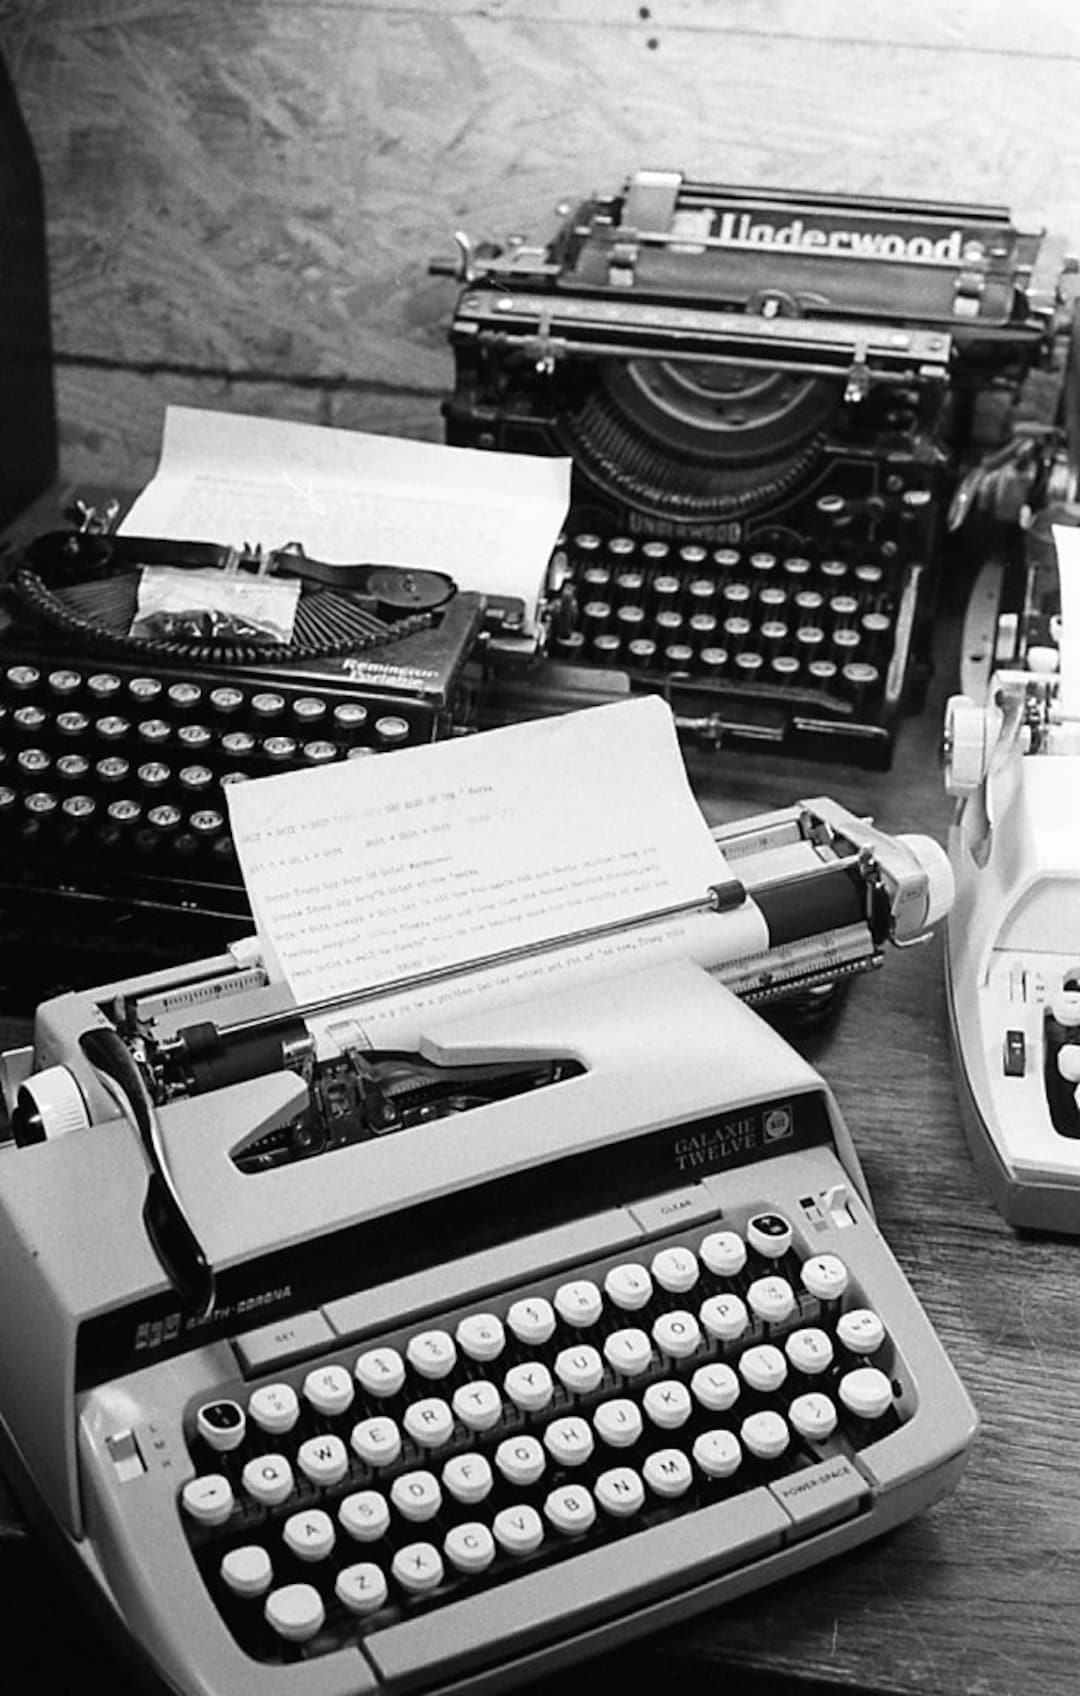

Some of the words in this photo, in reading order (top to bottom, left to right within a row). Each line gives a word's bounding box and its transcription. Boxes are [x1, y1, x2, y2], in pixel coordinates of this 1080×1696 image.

[674, 1117, 756, 1155] GALAXIE
[675, 1134, 757, 1171] TWELVE
[660, 1200, 691, 1215] CLEAR
[715, 1303, 731, 1318] P
[670, 1321, 686, 1336] O
[571, 1356, 591, 1370] U
[522, 1373, 536, 1387] Y
[708, 1375, 727, 1387] L
[469, 1393, 484, 1406] T
[660, 1390, 679, 1404] K
[421, 1410, 439, 1424] R
[616, 1409, 628, 1423] J
[367, 1428, 385, 1442] E
[561, 1428, 579, 1442] H
[316, 1446, 334, 1461] W
[262, 1466, 279, 1480] Q
[460, 1465, 475, 1479] F
[660, 1460, 681, 1475] M
[612, 1481, 631, 1495] N
[563, 1498, 581, 1513] B
[305, 1523, 320, 1537] A
[510, 1518, 526, 1531] V
[463, 1534, 479, 1549] C
[413, 1556, 429, 1571] X
[355, 1574, 371, 1591] Z
